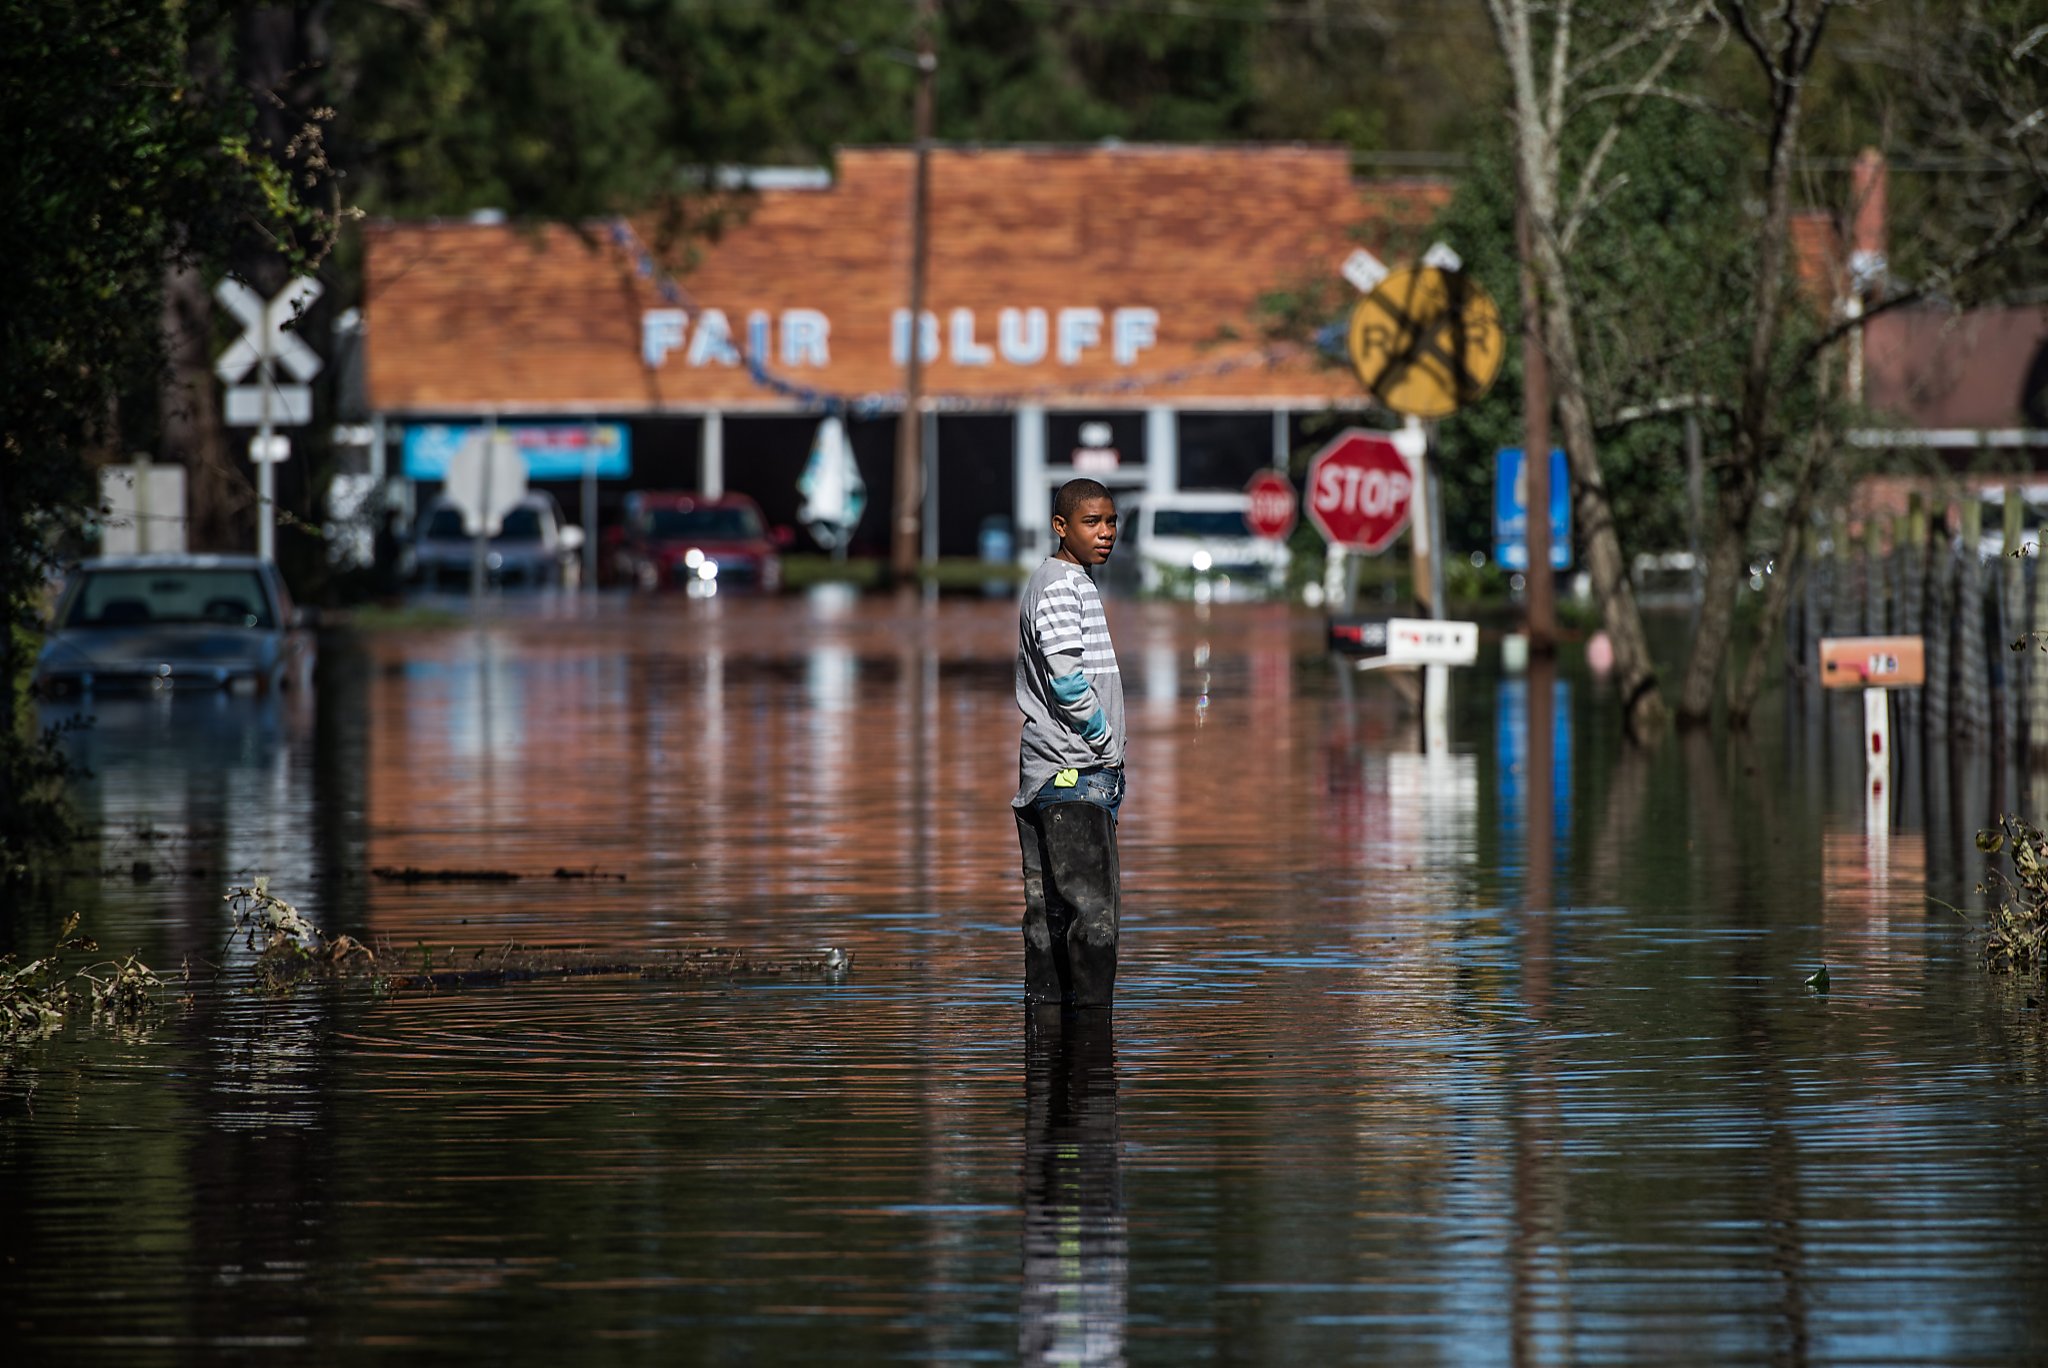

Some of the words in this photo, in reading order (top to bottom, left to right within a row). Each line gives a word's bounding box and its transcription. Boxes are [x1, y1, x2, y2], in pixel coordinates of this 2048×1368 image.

[641, 308, 831, 367] FAIR
[892, 307, 1159, 366] BLUFF
[1362, 322, 1397, 360] R
[1317, 463, 1412, 518] STOP
